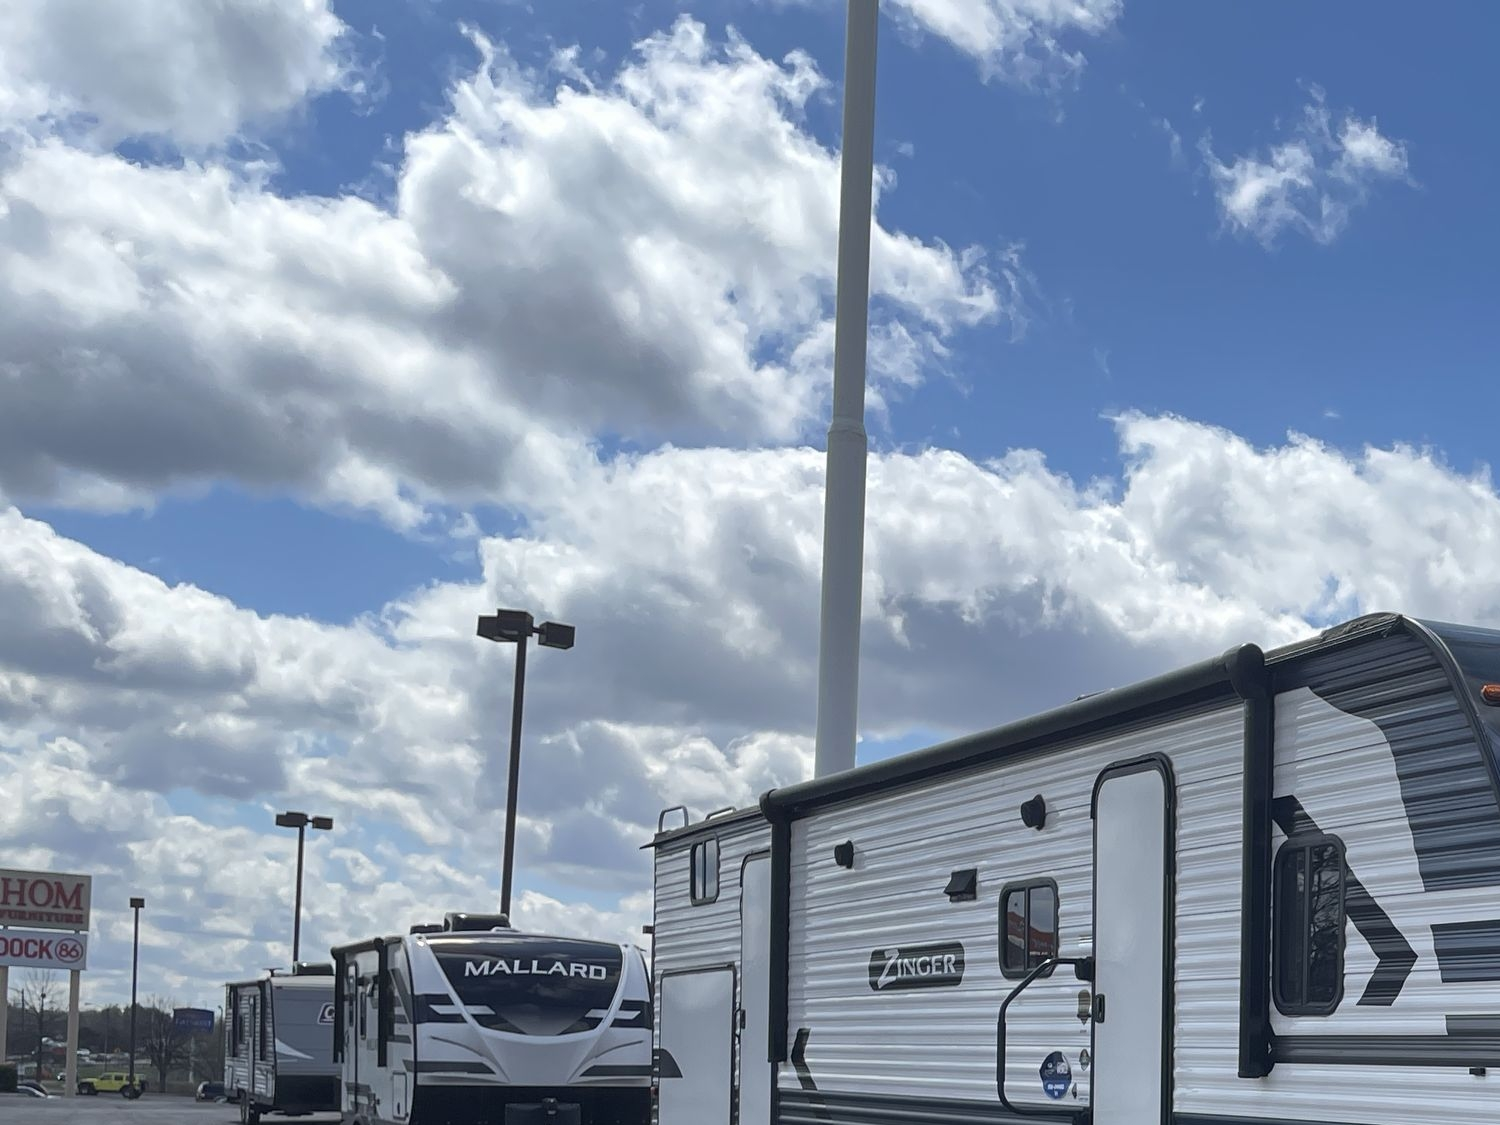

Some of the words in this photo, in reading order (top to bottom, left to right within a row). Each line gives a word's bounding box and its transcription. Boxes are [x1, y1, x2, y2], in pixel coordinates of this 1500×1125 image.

[0, 877, 84, 911] HOM
[59, 943, 79, 958] 86
[464, 959, 607, 981] MALLARD
[877, 948, 957, 990] ZINGER
